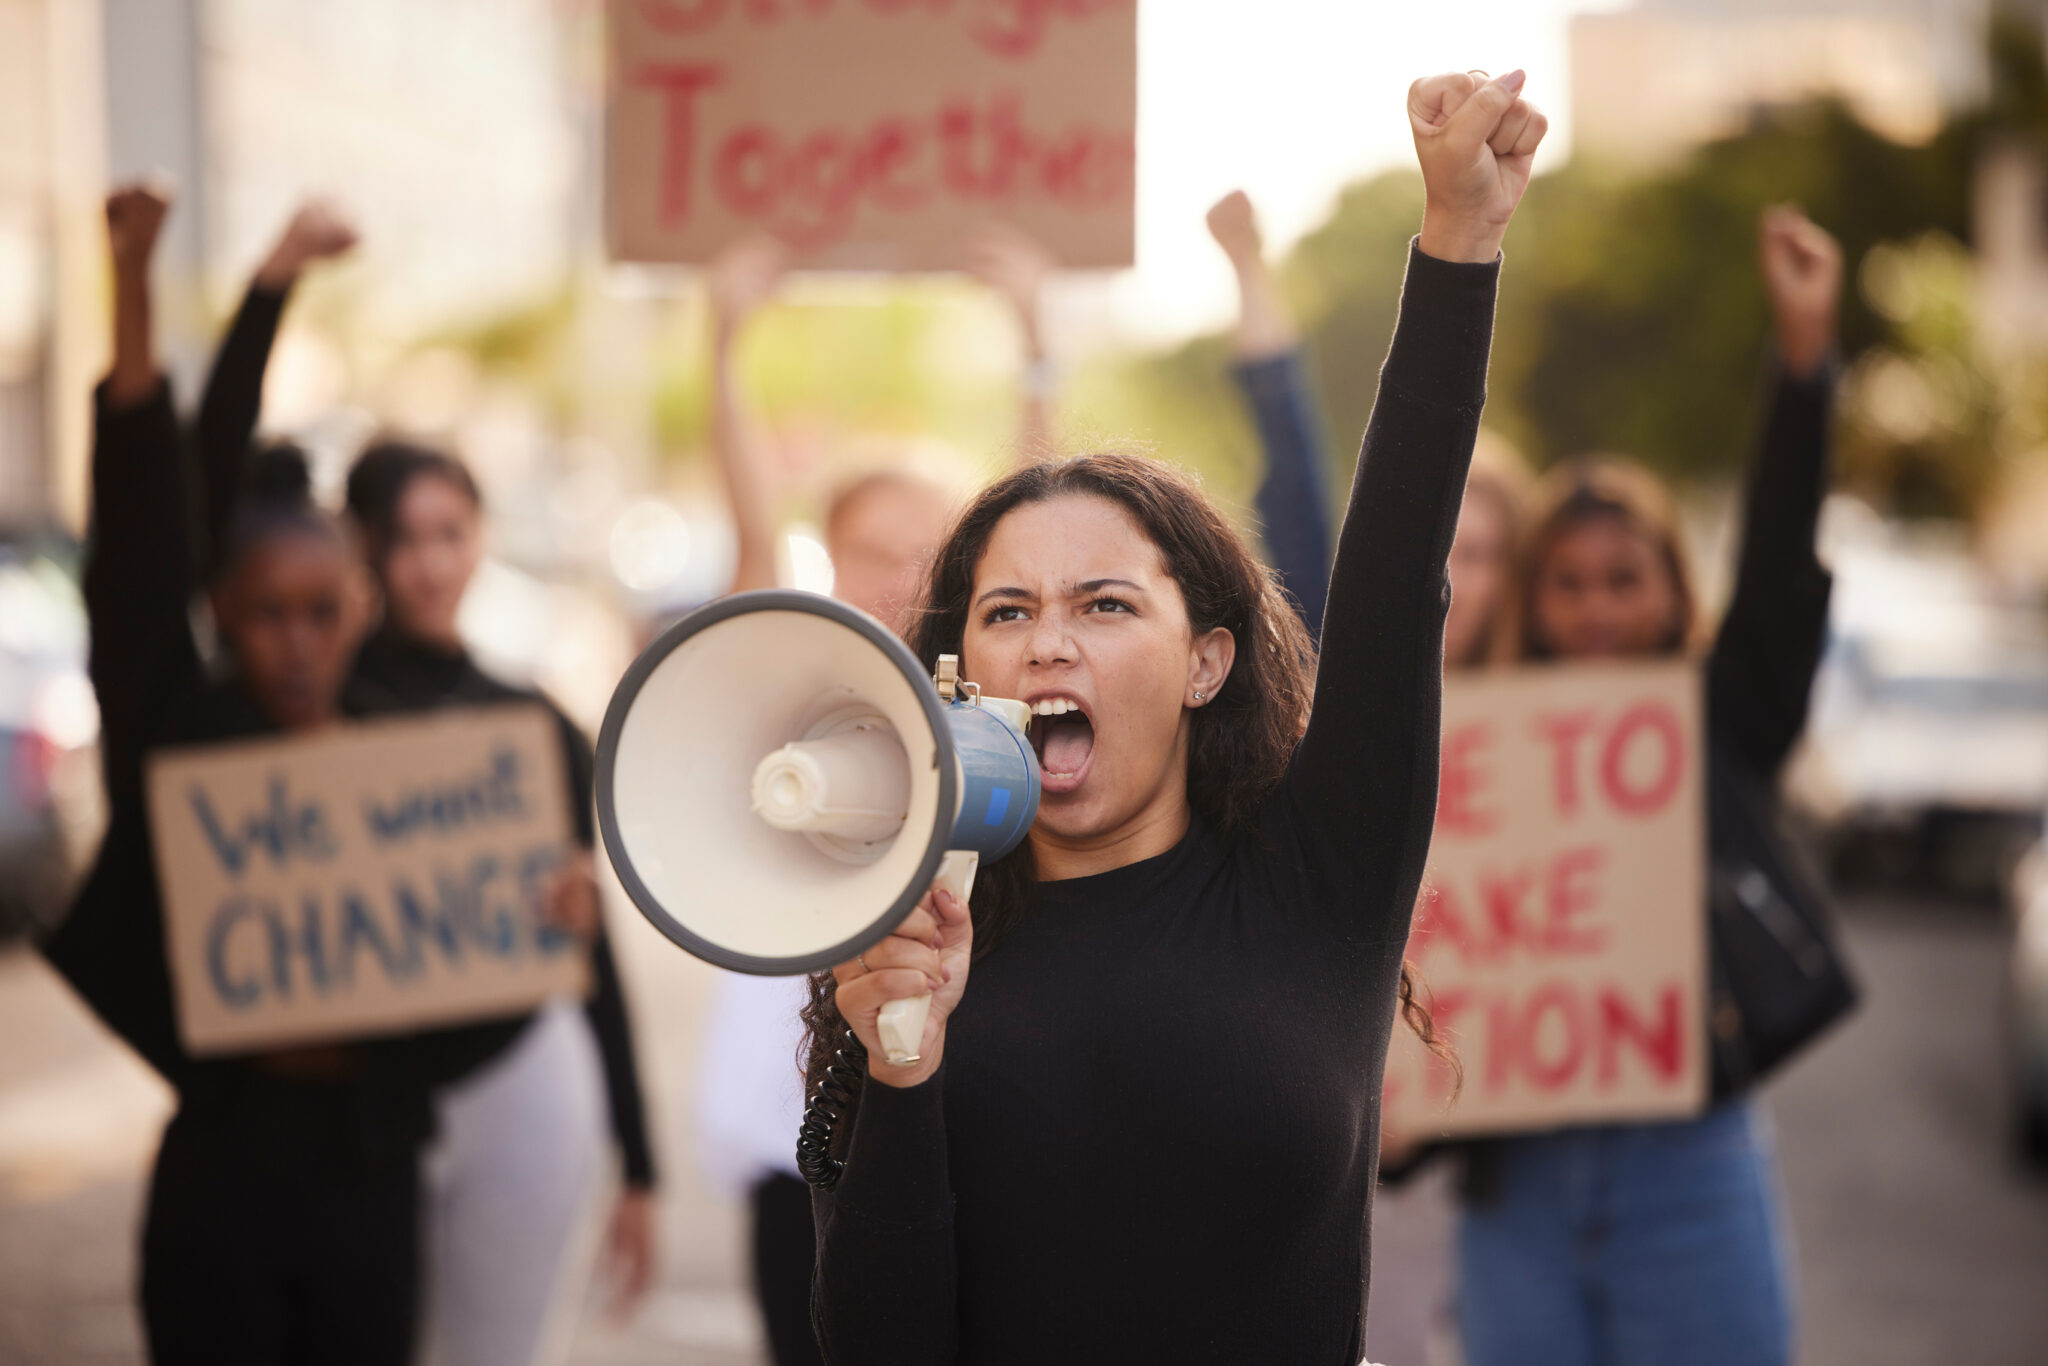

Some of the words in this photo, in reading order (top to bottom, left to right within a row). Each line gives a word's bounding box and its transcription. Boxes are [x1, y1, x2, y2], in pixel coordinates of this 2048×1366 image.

[186, 770, 338, 882] We
[364, 742, 530, 842] want
[1534, 700, 1688, 818] TO
[1404, 845, 1608, 964] AKE
[1382, 980, 1686, 1106] TION
